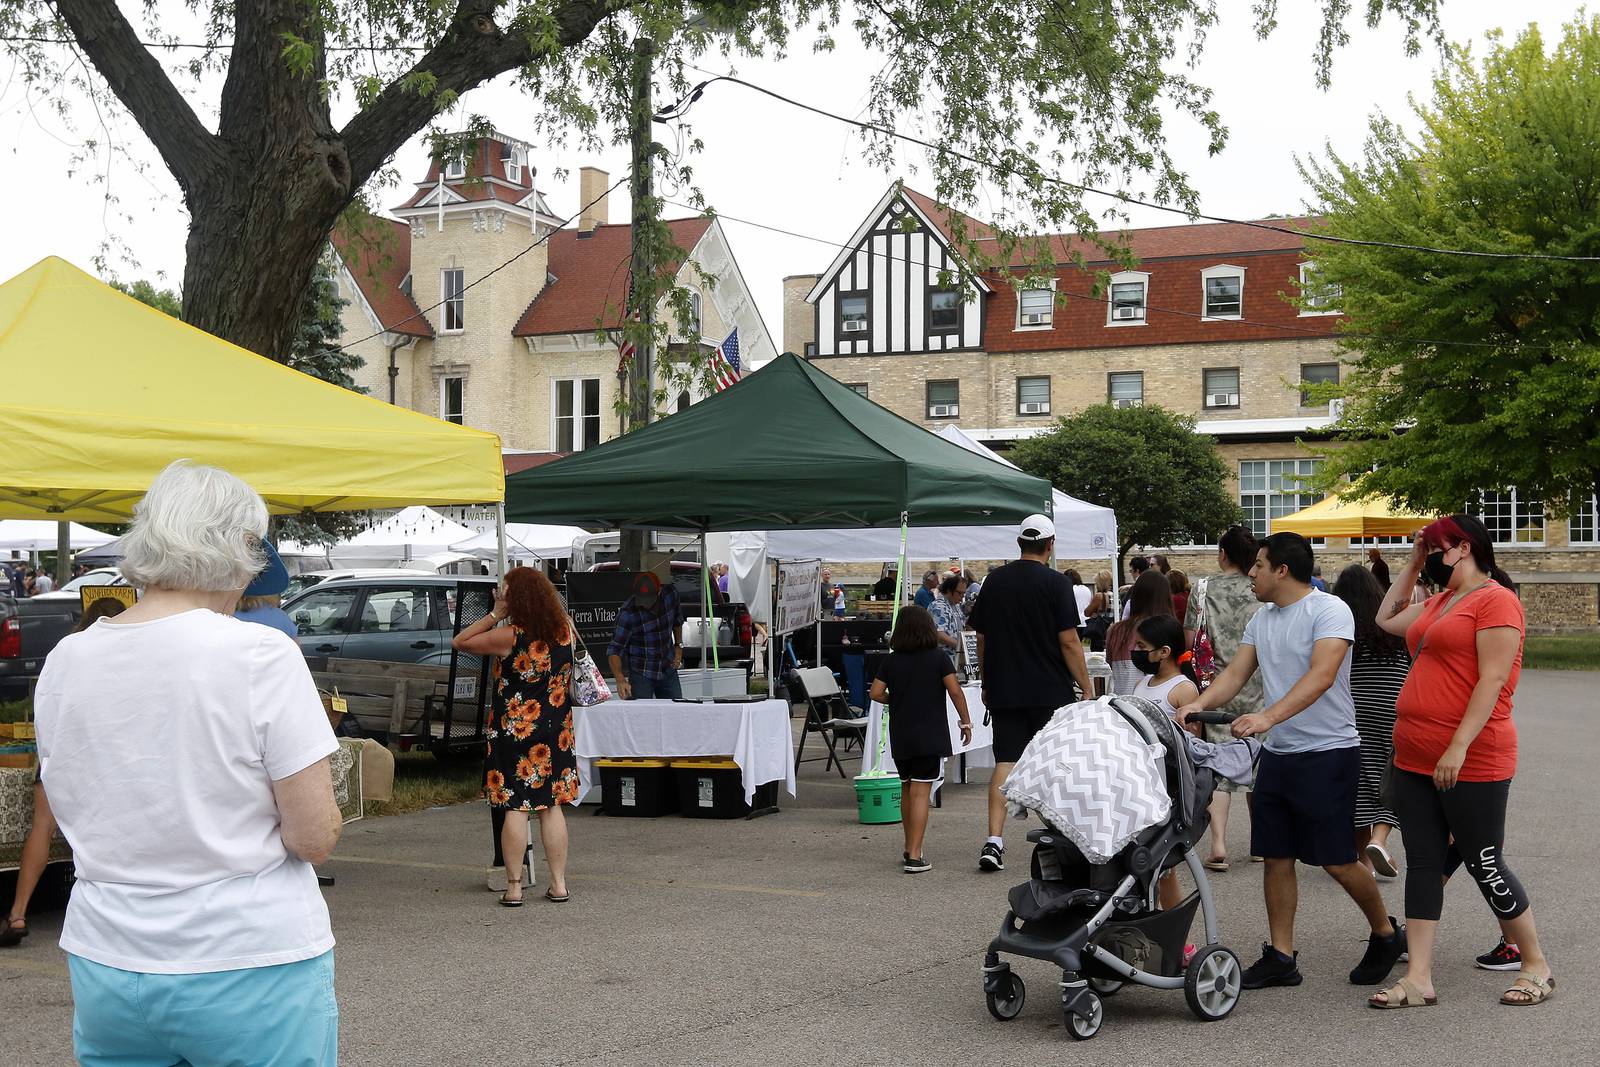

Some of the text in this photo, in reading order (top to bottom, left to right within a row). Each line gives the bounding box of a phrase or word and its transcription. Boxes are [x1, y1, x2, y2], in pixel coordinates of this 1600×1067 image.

[466, 512, 496, 521] WATER
[115, 587, 134, 605] FARM
[569, 608, 592, 623] Terra
[594, 607, 616, 622] Vitae
